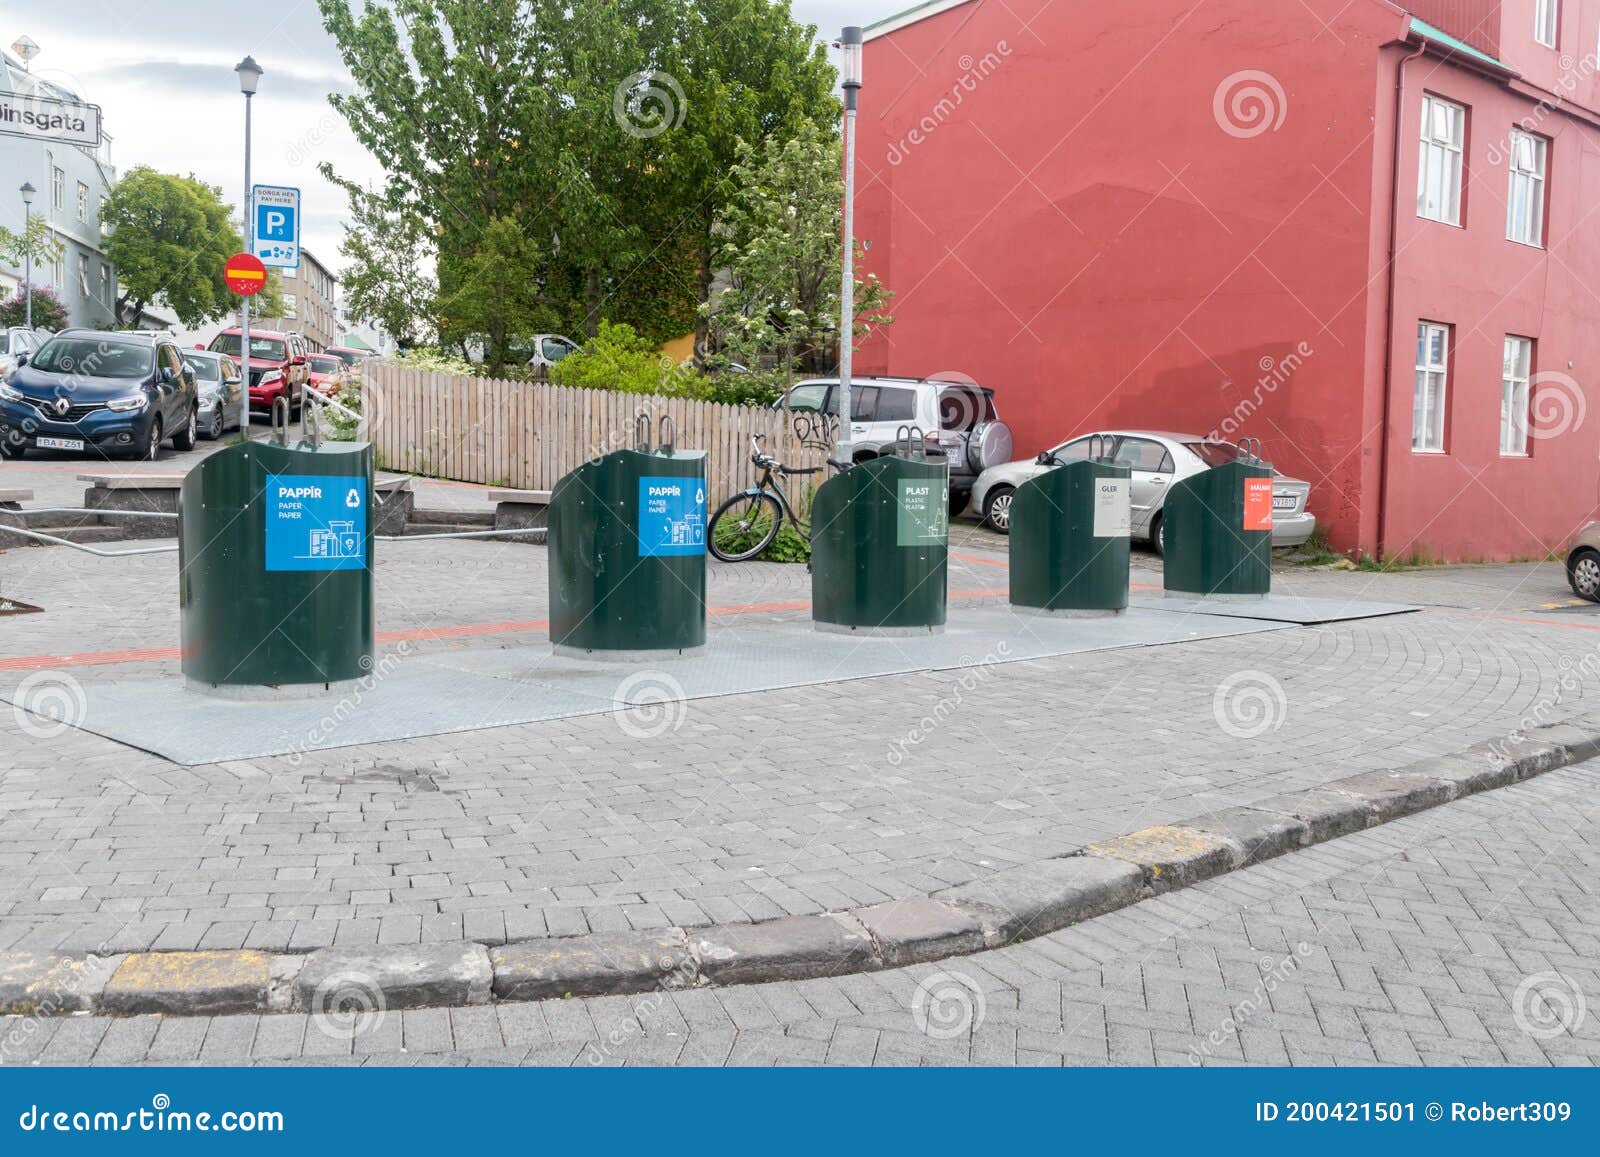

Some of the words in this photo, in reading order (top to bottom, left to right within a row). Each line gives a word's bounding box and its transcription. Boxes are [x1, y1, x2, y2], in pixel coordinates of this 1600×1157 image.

[278, 485, 322, 499] PAPPÍR
[648, 485, 681, 497] PAPPÍR
[906, 487, 930, 496] PLAST
[278, 502, 302, 510] PAPER
[278, 511, 302, 519] PAPIER
